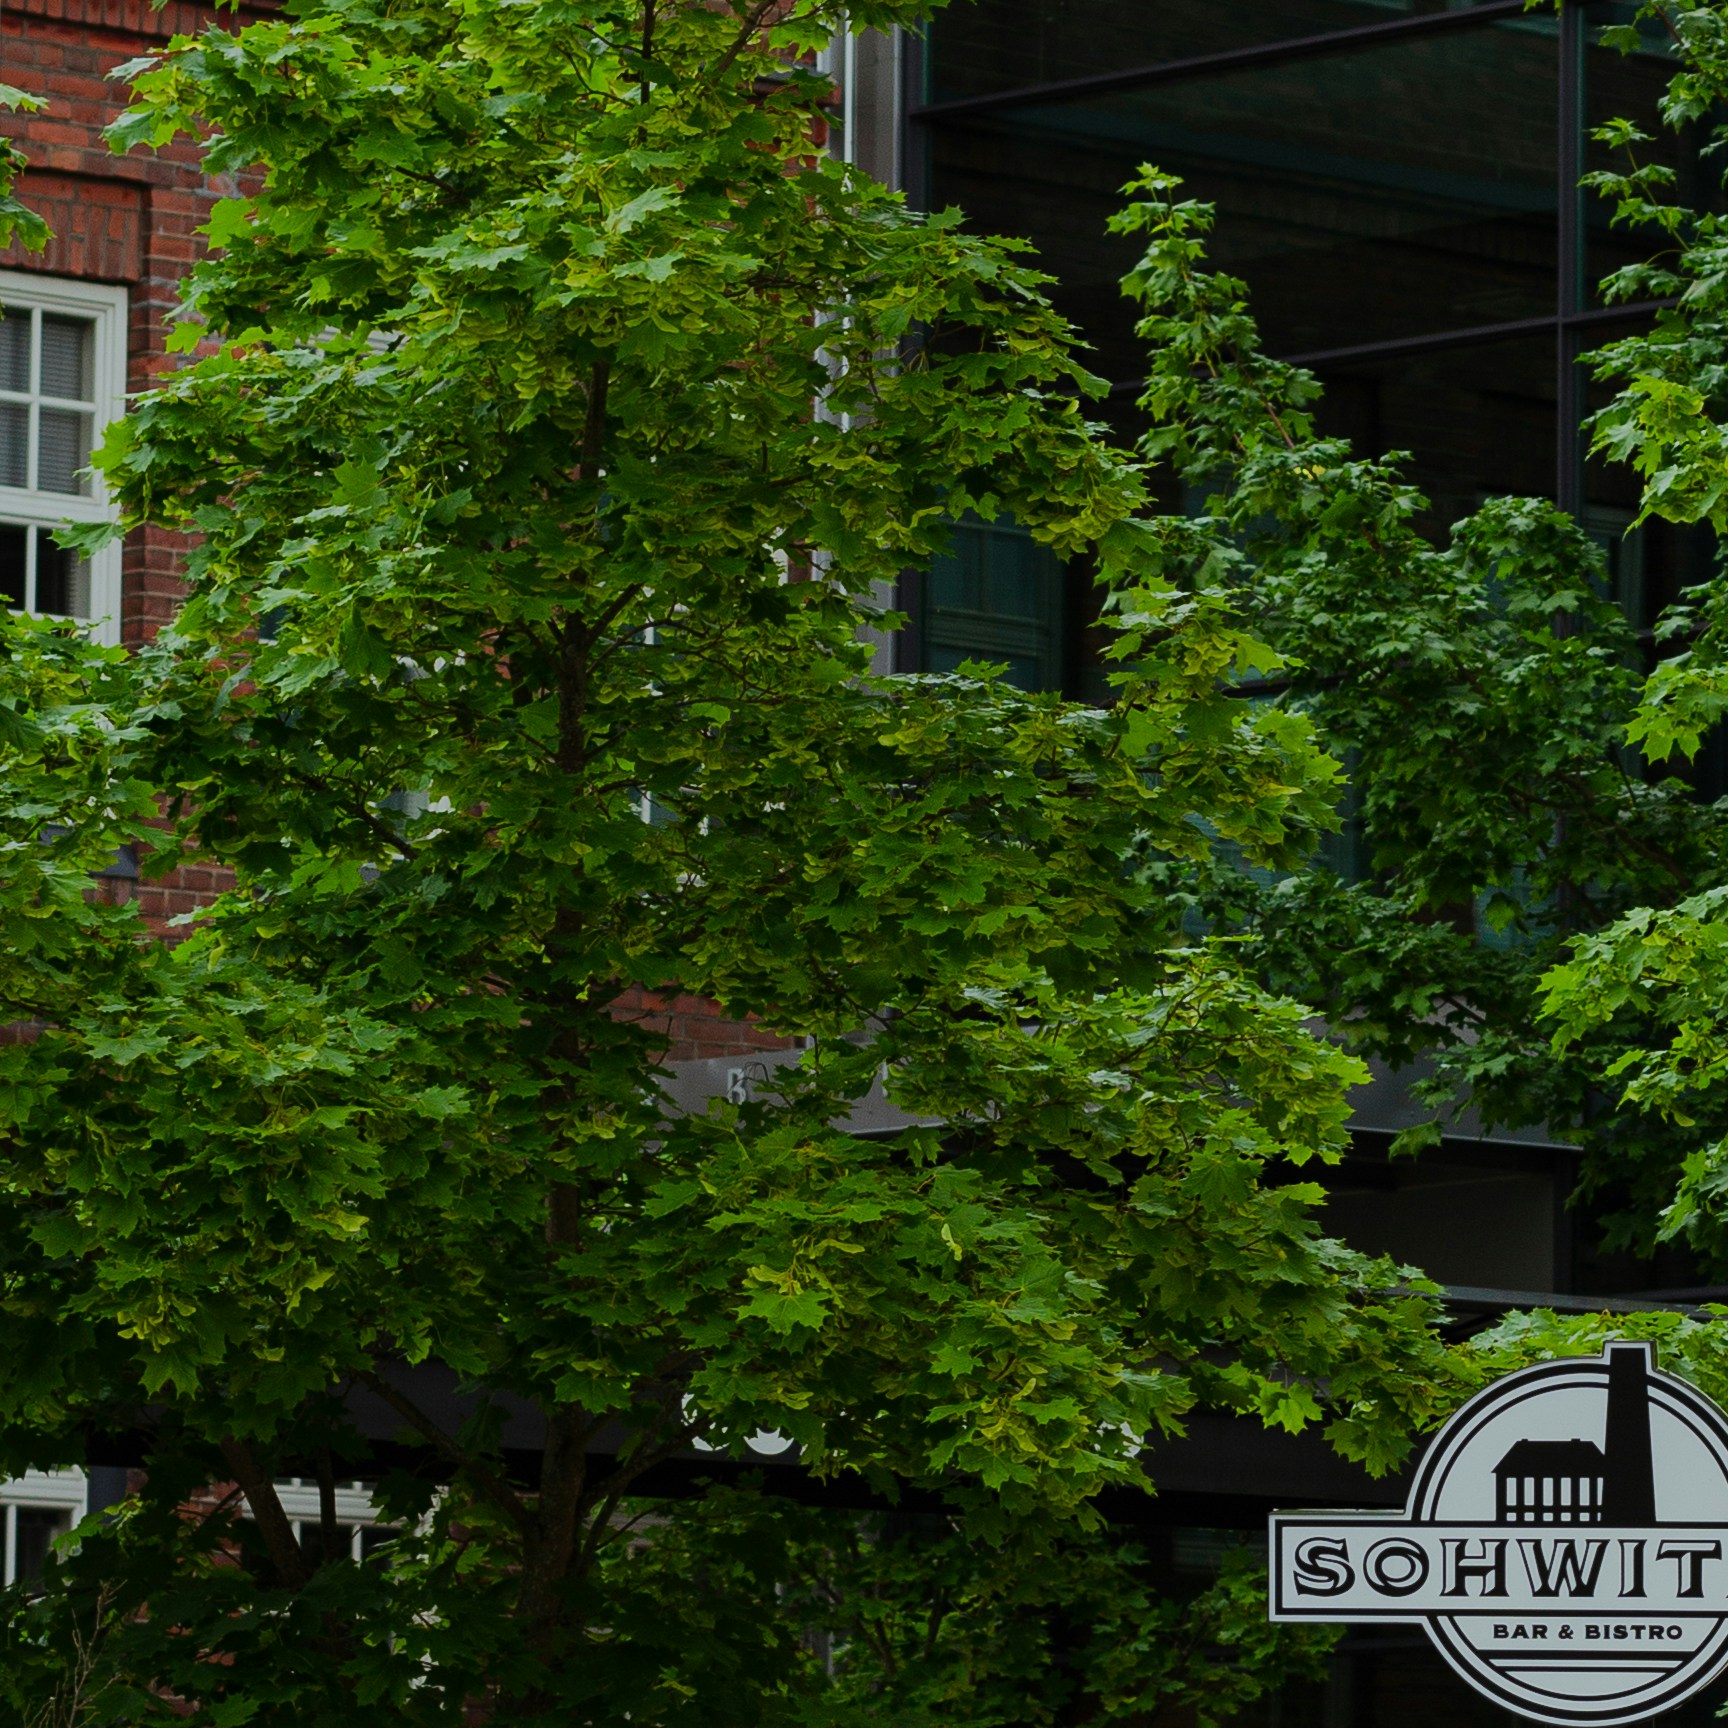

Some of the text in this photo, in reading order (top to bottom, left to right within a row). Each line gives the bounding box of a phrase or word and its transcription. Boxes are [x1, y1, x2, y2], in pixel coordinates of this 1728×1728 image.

[1493, 1624, 1683, 1641] BAR & BISTRO
